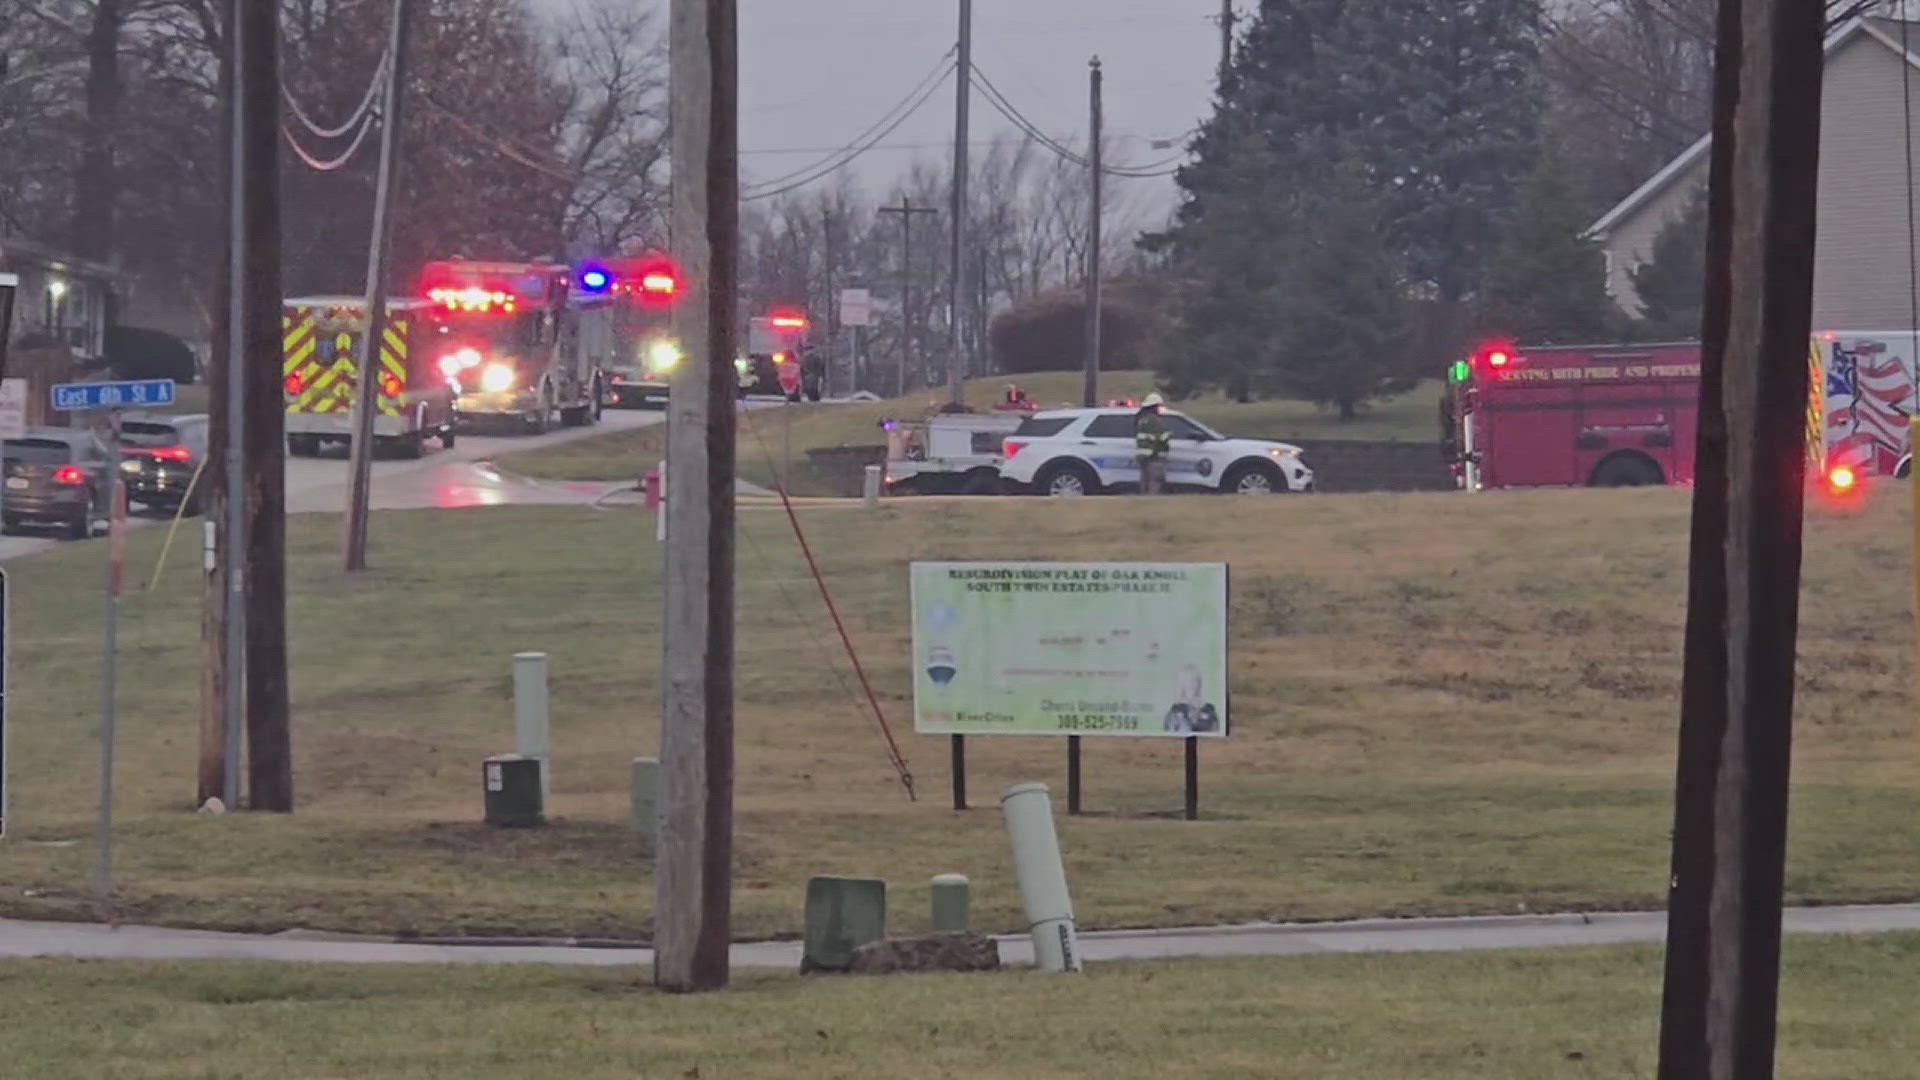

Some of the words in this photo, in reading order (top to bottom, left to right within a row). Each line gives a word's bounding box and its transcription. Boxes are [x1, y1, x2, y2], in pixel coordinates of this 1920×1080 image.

[1551, 367, 1582, 379] WITH
[1585, 366, 1619, 378] PRIDE
[1625, 366, 1649, 377] AND
[58, 387, 88, 406] East
[131, 383, 147, 403] St
[158, 383, 169, 401] A
[1055, 569, 1087, 579] PLAT
[967, 582, 1011, 592] SOUTH
